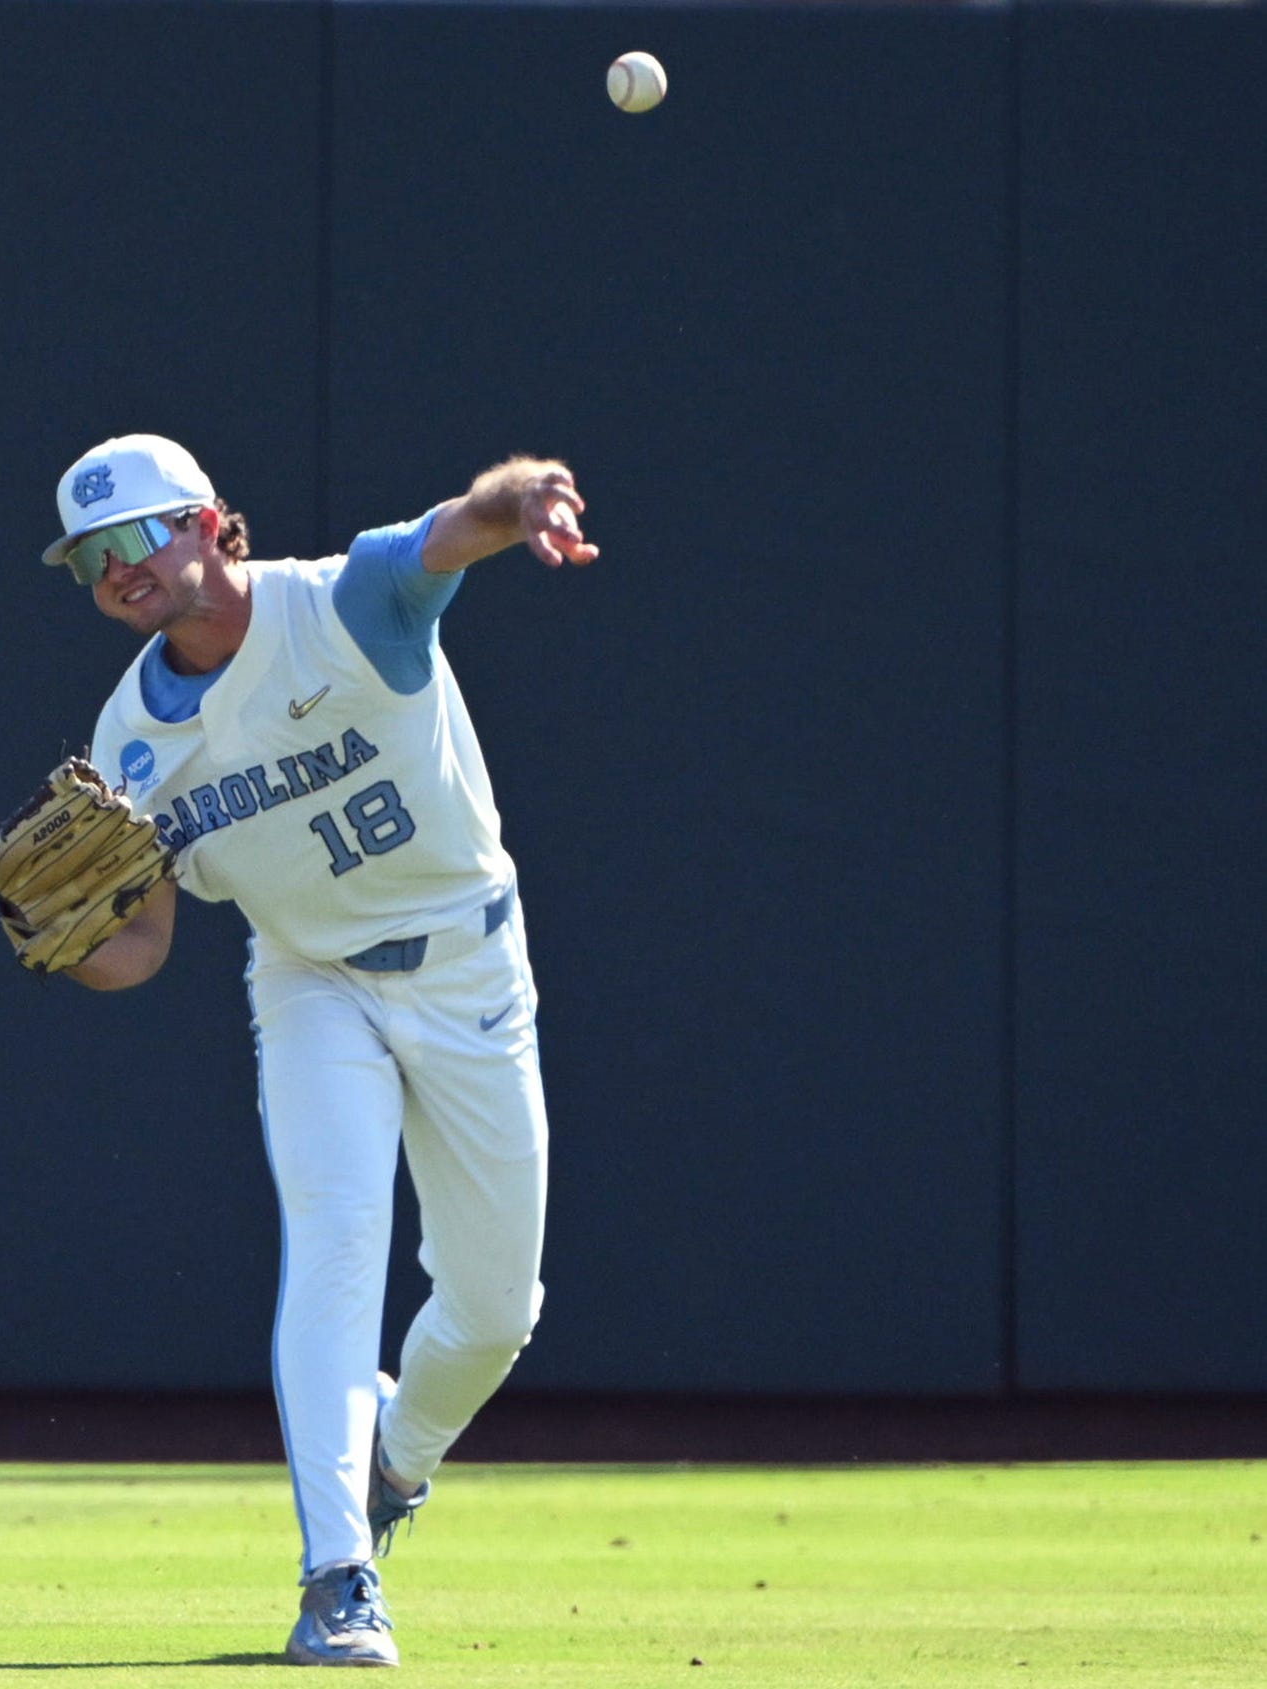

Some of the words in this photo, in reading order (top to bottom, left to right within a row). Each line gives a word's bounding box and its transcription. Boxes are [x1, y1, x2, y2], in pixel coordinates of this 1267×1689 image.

[33, 809, 71, 846] A2000
[154, 727, 380, 851] CAROLINA
[309, 779, 416, 877] 18
